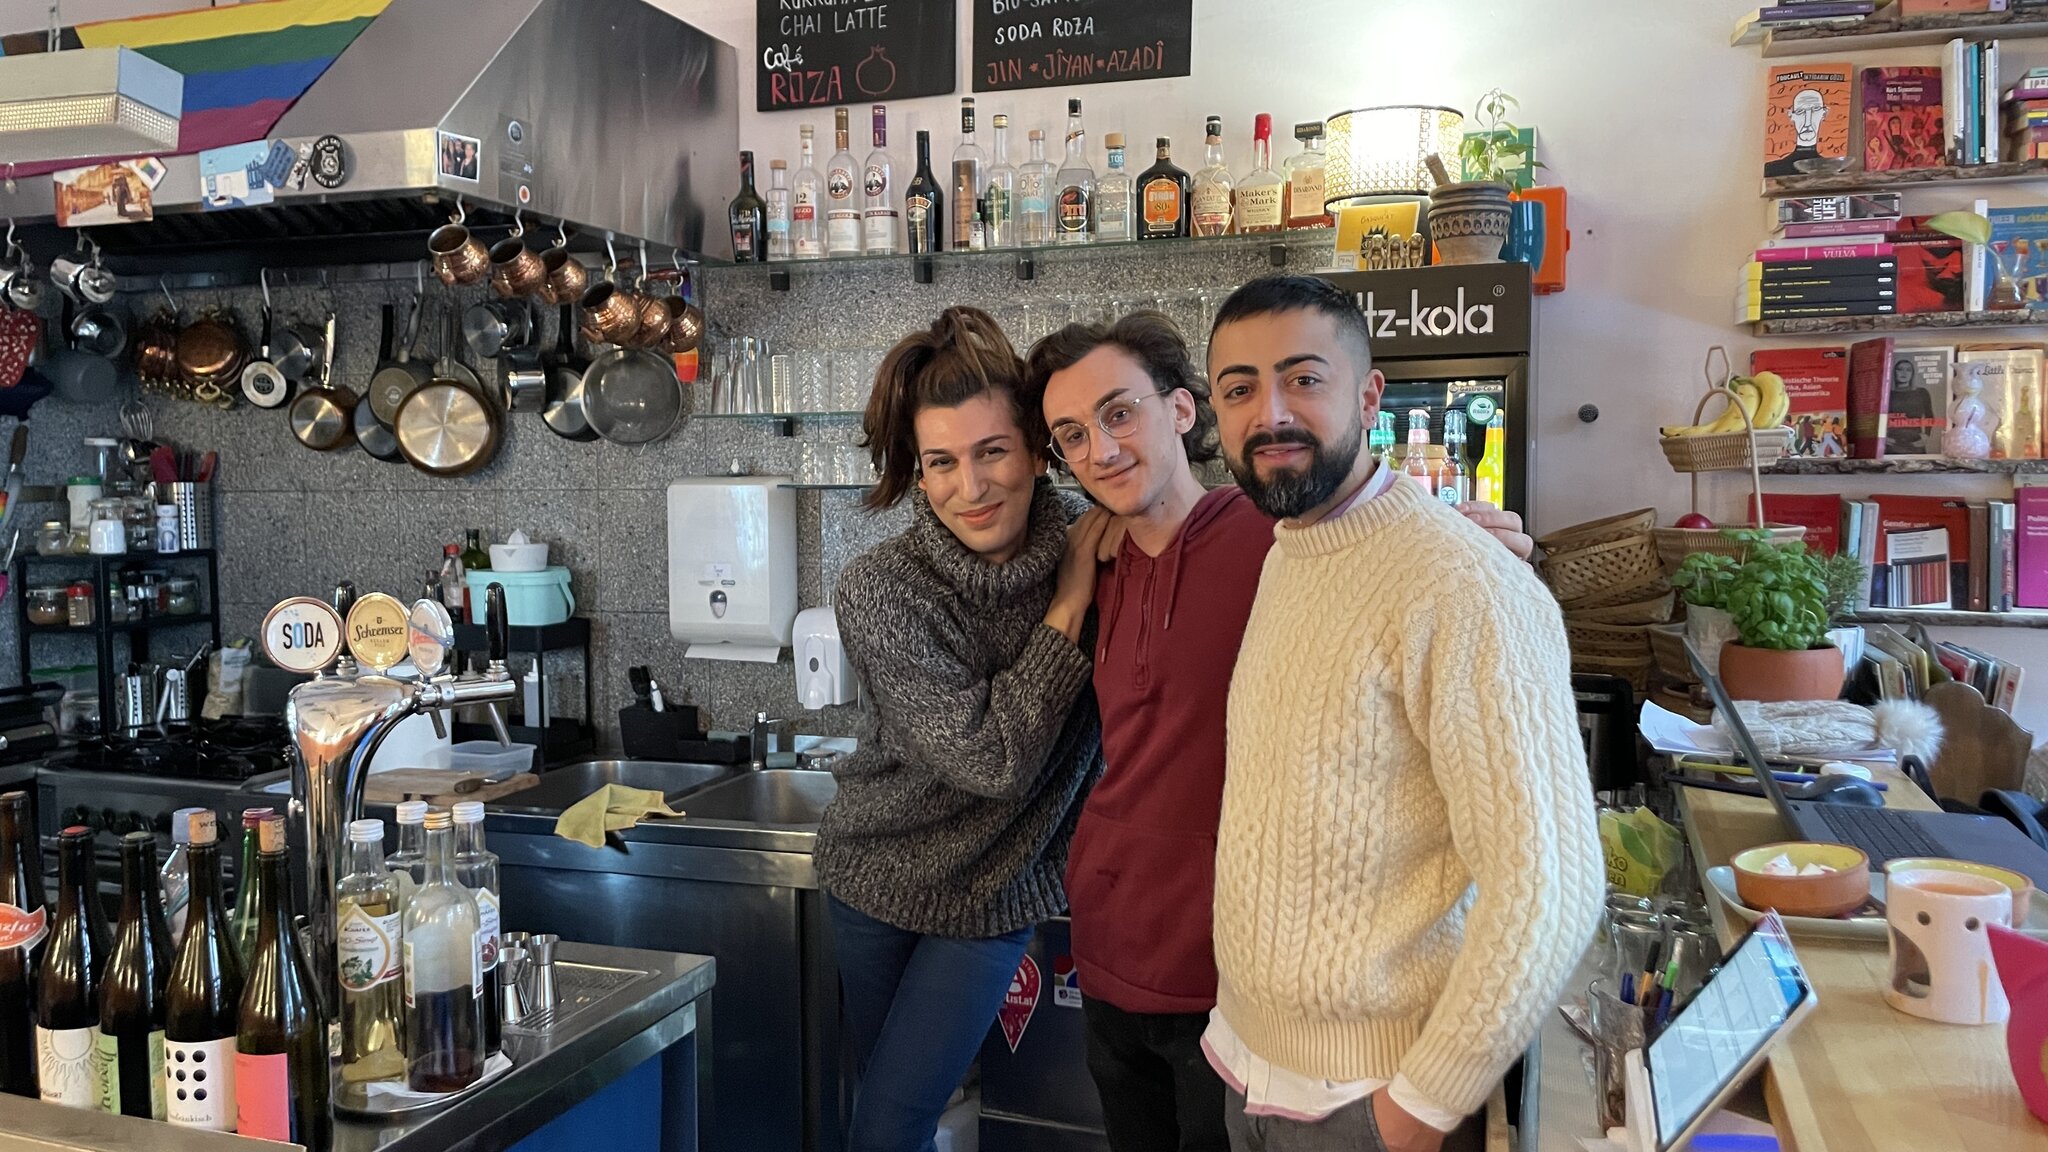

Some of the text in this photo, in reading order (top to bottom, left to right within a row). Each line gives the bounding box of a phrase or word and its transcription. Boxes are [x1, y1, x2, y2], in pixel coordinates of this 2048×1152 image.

[780, 5, 887, 36] CHAI LATTE
[994, 21, 1042, 45] SODA
[764, 43, 804, 72] Café
[987, 40, 1164, 85] JIN JÎYAN AZADÎ
[771, 65, 843, 105] ROZA
[1240, 188, 1278, 198] Maker's
[1250, 196, 1277, 206] Mark
[1813, 198, 1823, 221] LITTLE
[1823, 198, 1837, 220] LIFE
[1822, 249, 1857, 258] VULVA
[1357, 286, 1494, 338] tz-kola
[1882, 519, 1912, 528] Gender
[282, 621, 325, 650] SODA
